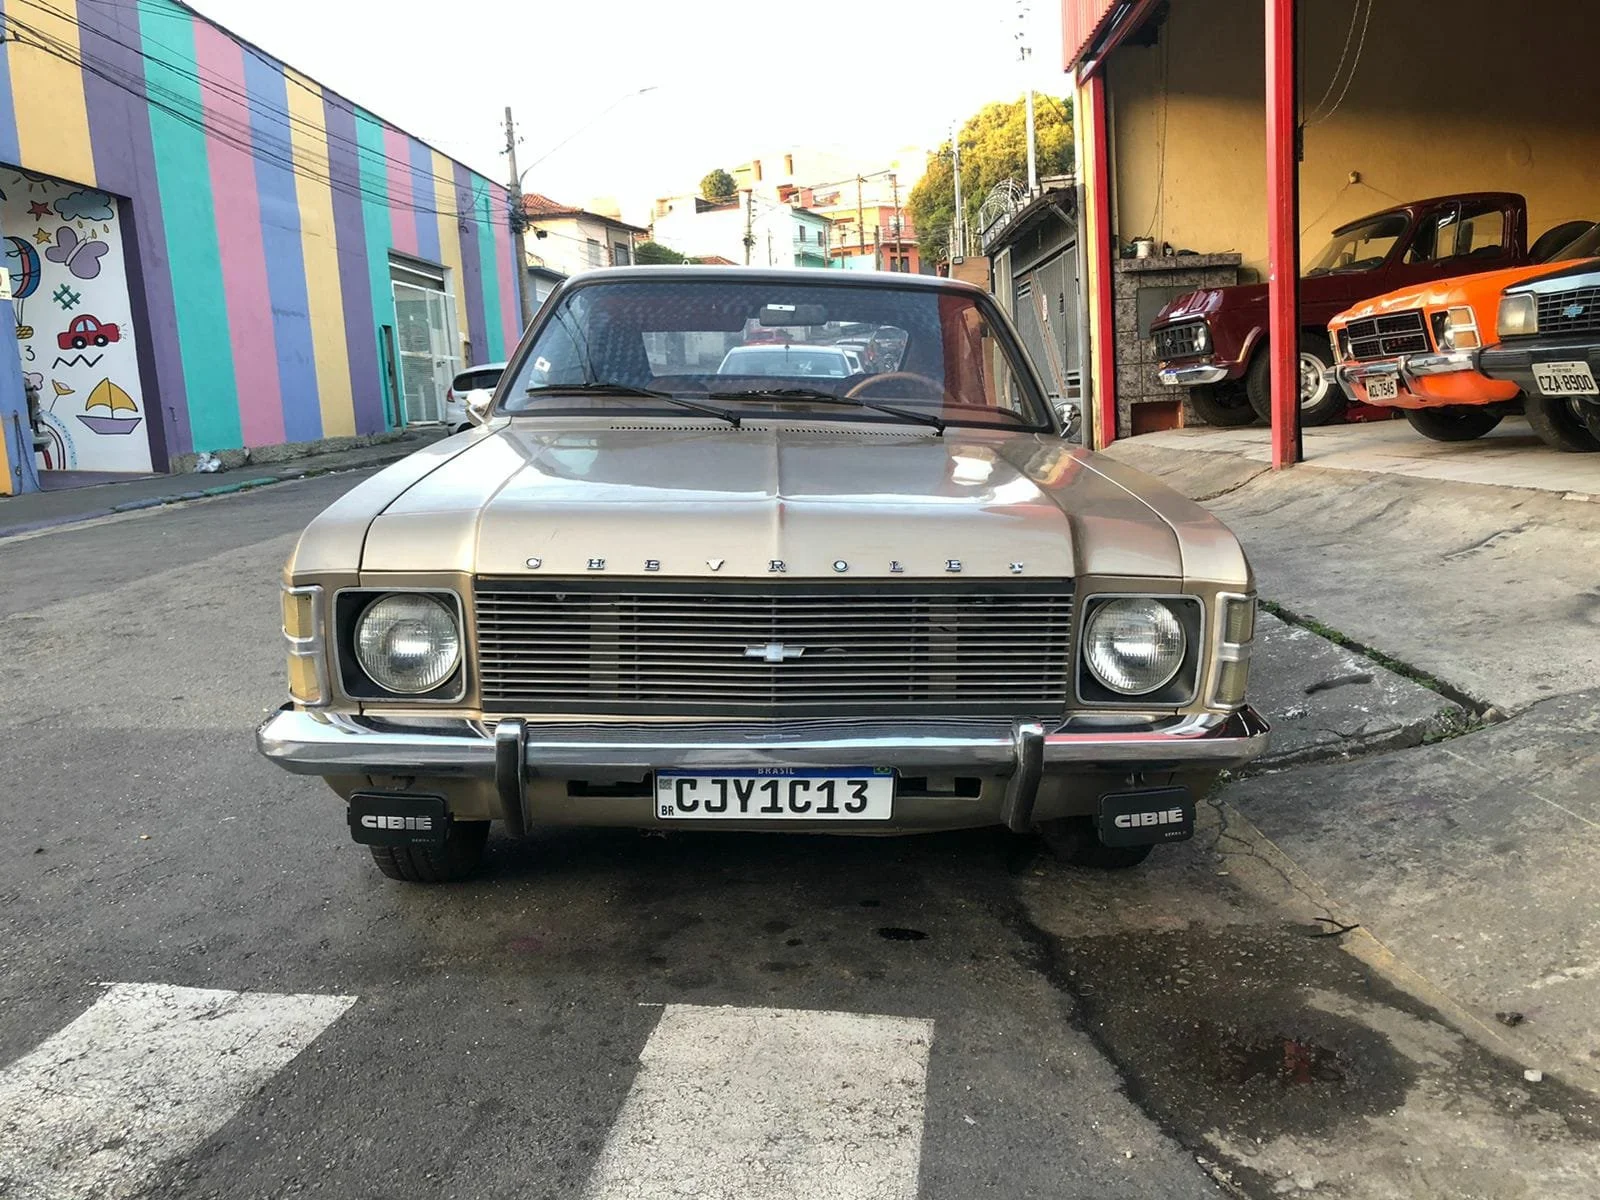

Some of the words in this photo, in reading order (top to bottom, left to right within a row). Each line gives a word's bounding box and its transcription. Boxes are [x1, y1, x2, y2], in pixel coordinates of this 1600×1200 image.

[525, 557, 1024, 574] CHEVROLET
[757, 767, 796, 775] BRASIL
[675, 778, 869, 814] CJY1C13
[661, 805, 675, 816] BR
